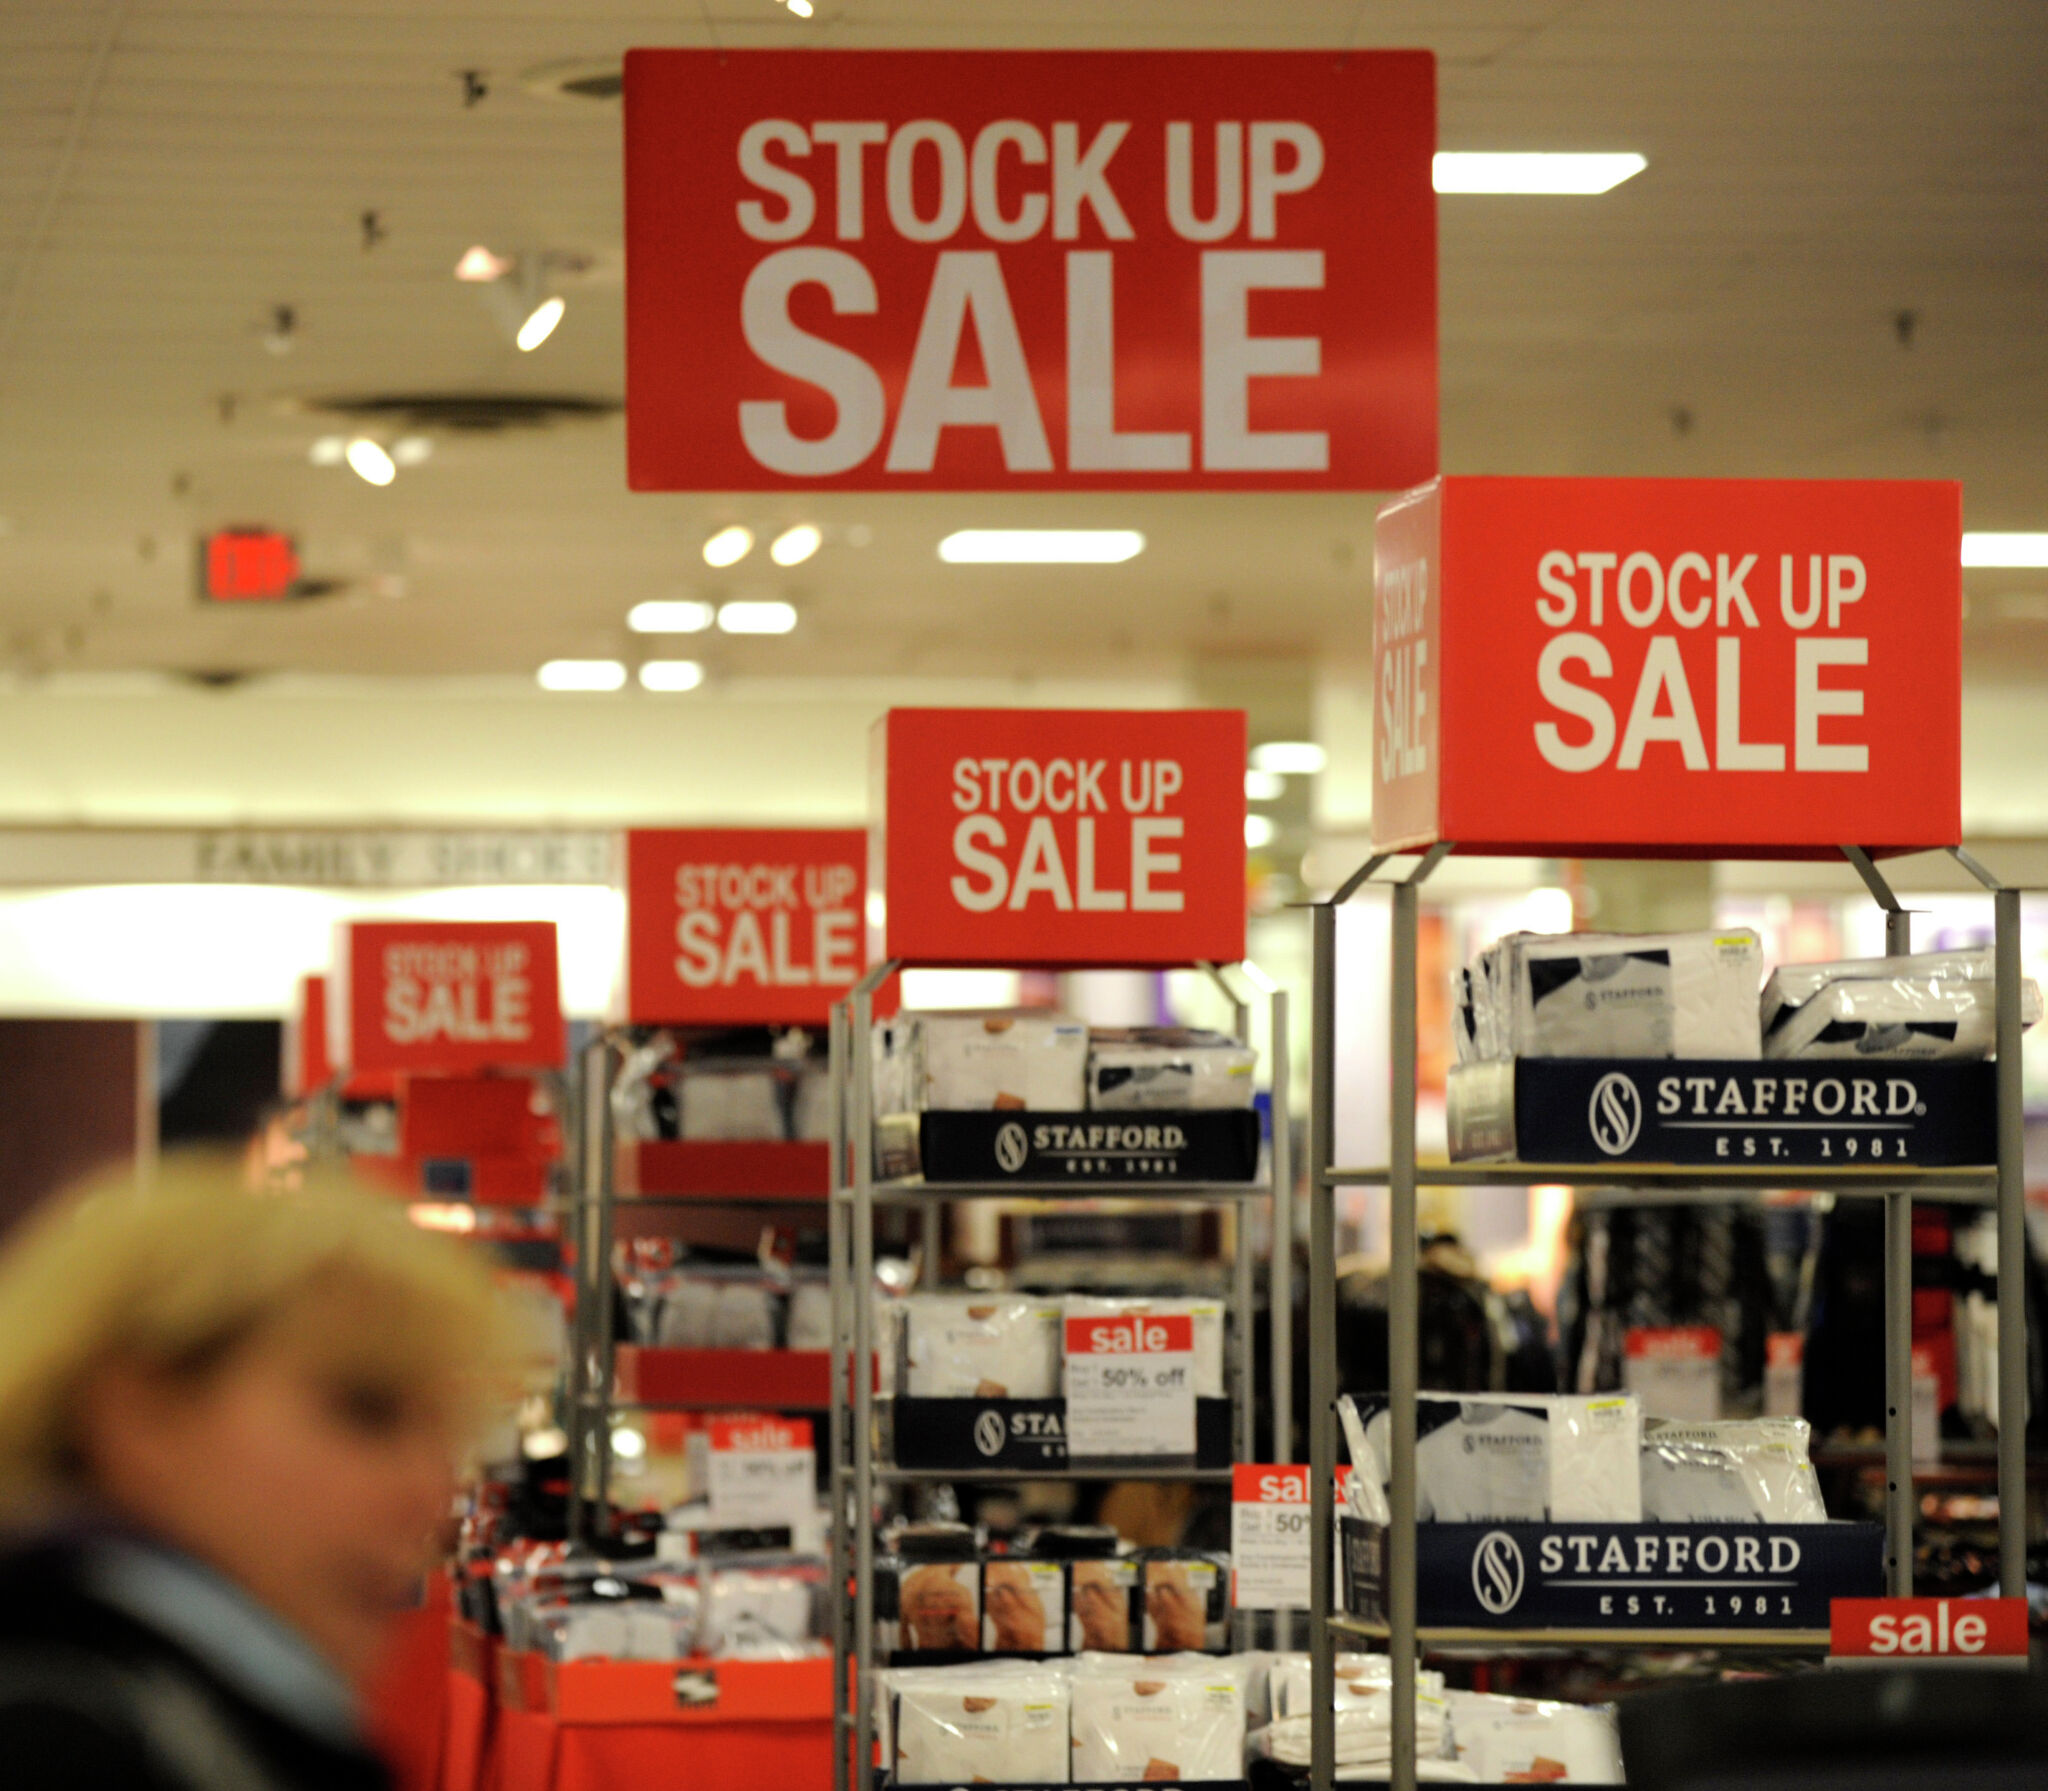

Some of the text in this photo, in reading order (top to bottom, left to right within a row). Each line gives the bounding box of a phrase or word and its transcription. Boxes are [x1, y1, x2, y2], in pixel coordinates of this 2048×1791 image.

[735, 118, 1326, 243] STOCK UP
[737, 245, 1331, 478] SALE
[1535, 549, 1868, 629] STOCK UP
[1533, 631, 1870, 773] SALE
[951, 757, 1184, 813] STOCK UP
[674, 862, 858, 911] STOCK UP
[950, 813, 1185, 913] SALE
[674, 909, 859, 988] SALE
[383, 978, 531, 1043] SALE
[1715, 1137, 1909, 1158] EST. 1981
[1089, 1317, 1169, 1354] sale
[1101, 1366, 1149, 1388] 50%
[1154, 1366, 1186, 1387] off
[1010, 1412, 1065, 1436] STA
[1259, 1466, 1342, 1502] sal
[1538, 1535, 1802, 1575] STAFFORD
[1600, 1595, 1793, 1616] EST. 1981
[1868, 1601, 1988, 1655] sale
